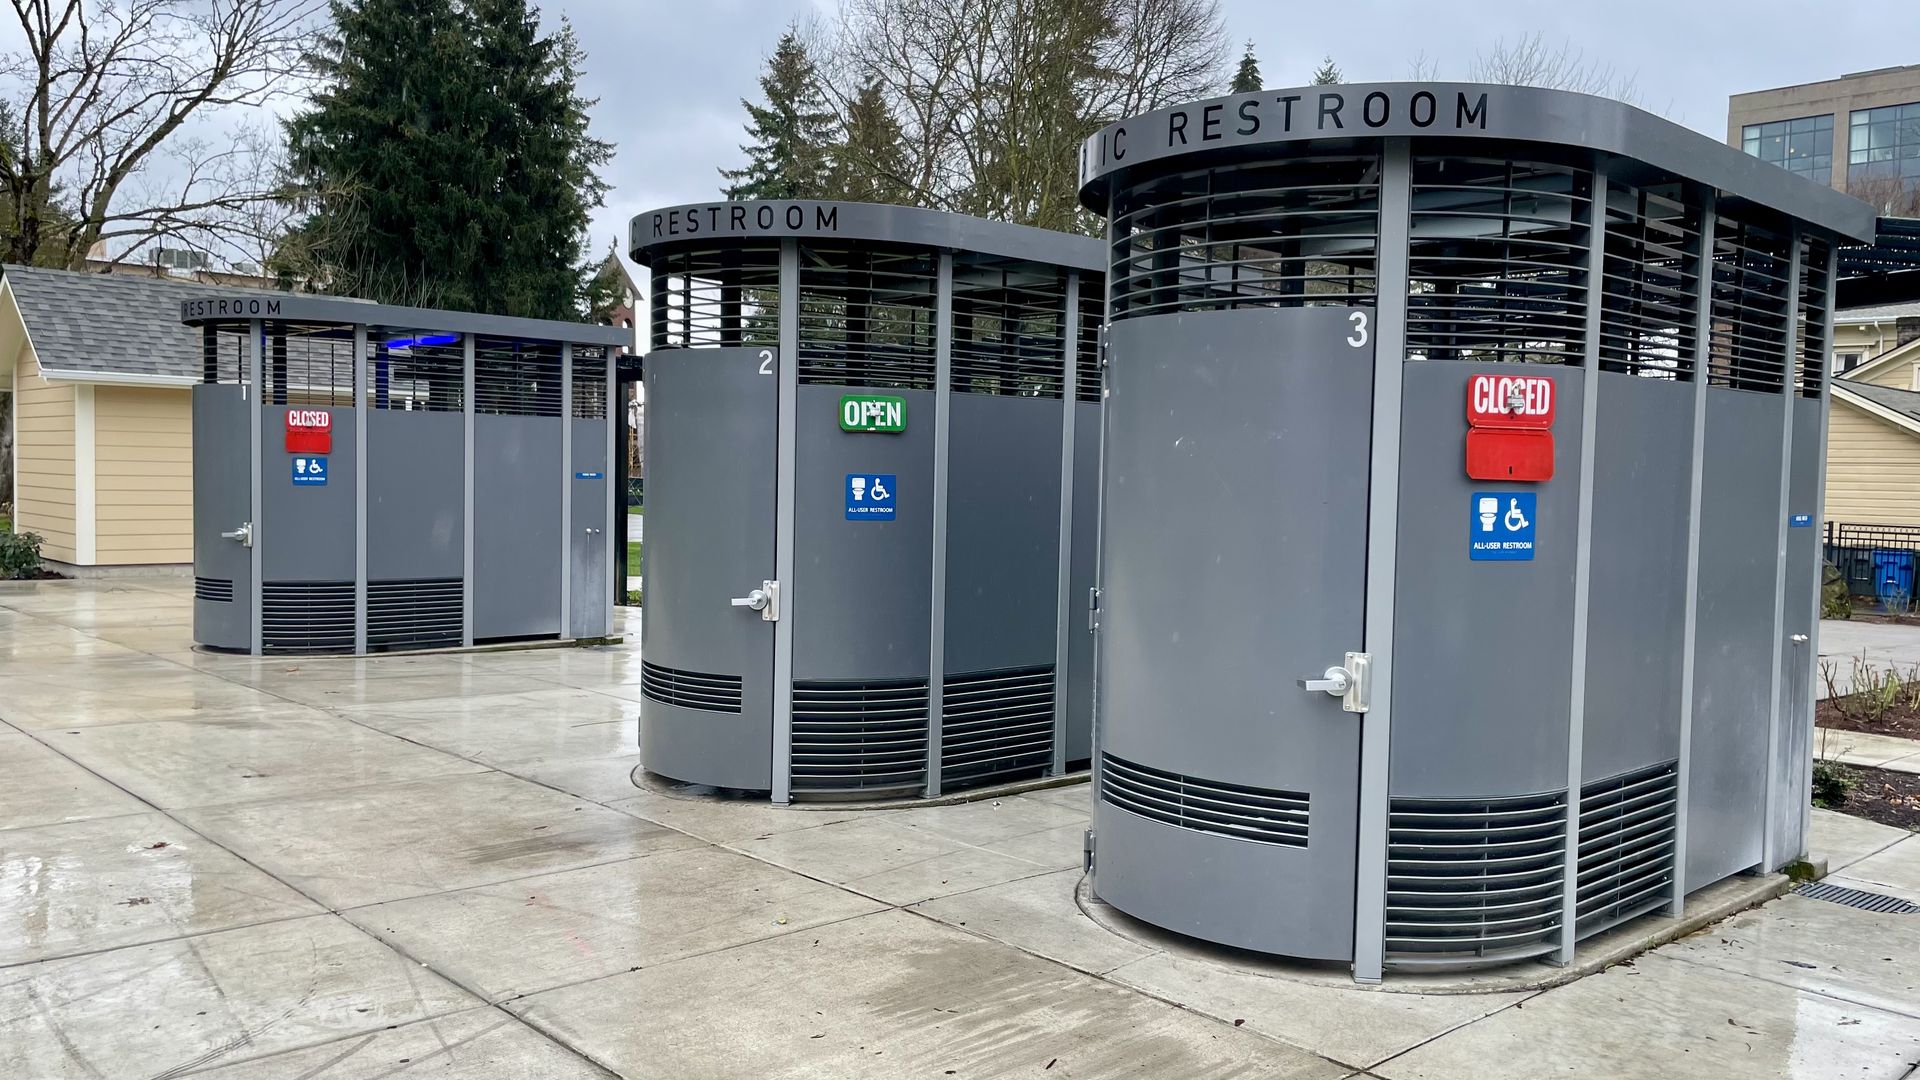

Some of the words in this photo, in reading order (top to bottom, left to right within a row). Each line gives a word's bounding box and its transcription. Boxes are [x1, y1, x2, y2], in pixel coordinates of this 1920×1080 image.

[1168, 90, 1488, 147] RESTROOM
[653, 205, 838, 238] RESTROOM
[183, 300, 280, 316] RESTROOM
[1346, 311, 1368, 348] 3
[758, 350, 773, 375] 2
[242, 385, 247, 400] 1
[1474, 376, 1551, 416] CLOSED
[288, 410, 329, 427] CLOSED
[844, 400, 902, 427] OPEN
[1473, 541, 1501, 550] ALL-USER
[1502, 541, 1533, 550] RESTROOM
